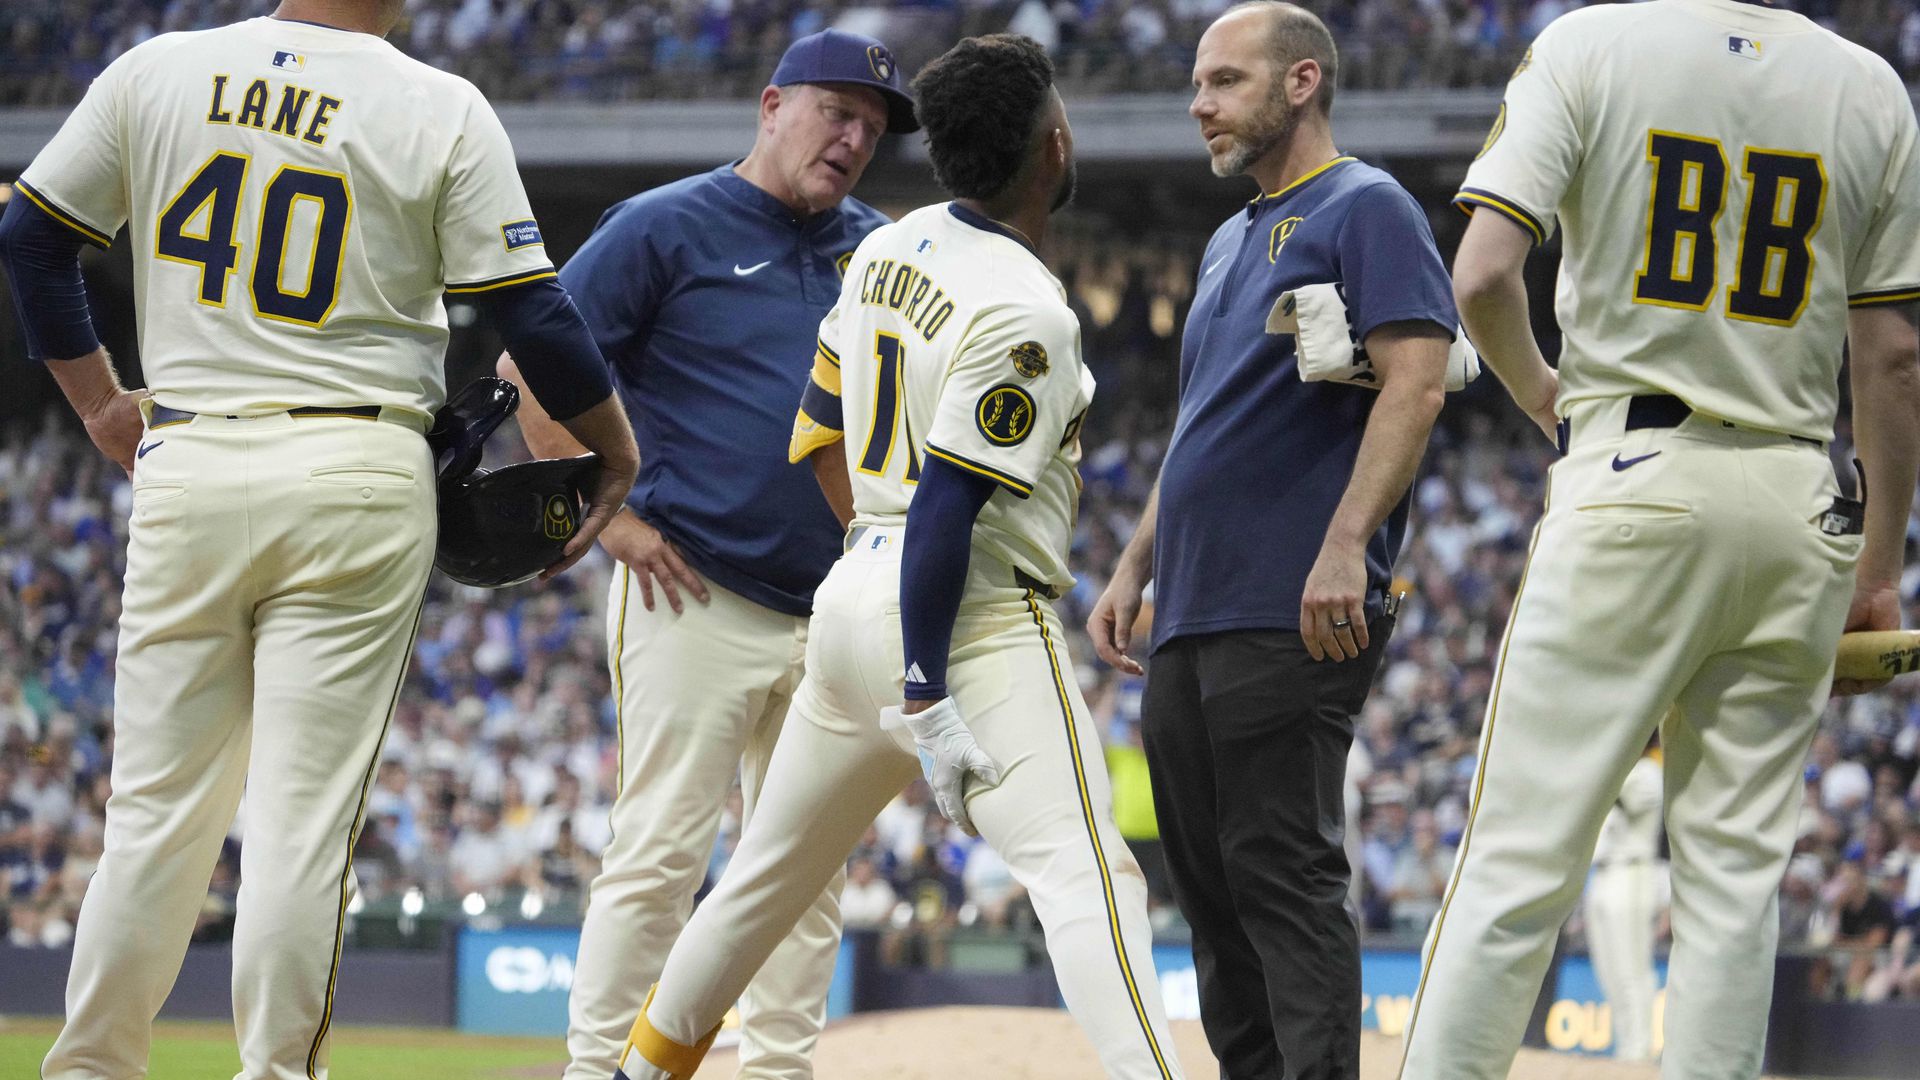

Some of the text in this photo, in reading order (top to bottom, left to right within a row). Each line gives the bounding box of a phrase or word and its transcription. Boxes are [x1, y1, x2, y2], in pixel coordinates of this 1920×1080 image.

[207, 74, 343, 147] LANE
[154, 149, 353, 329] 40
[1632, 128, 1829, 328] BB
[860, 259, 956, 344] CHORIO
